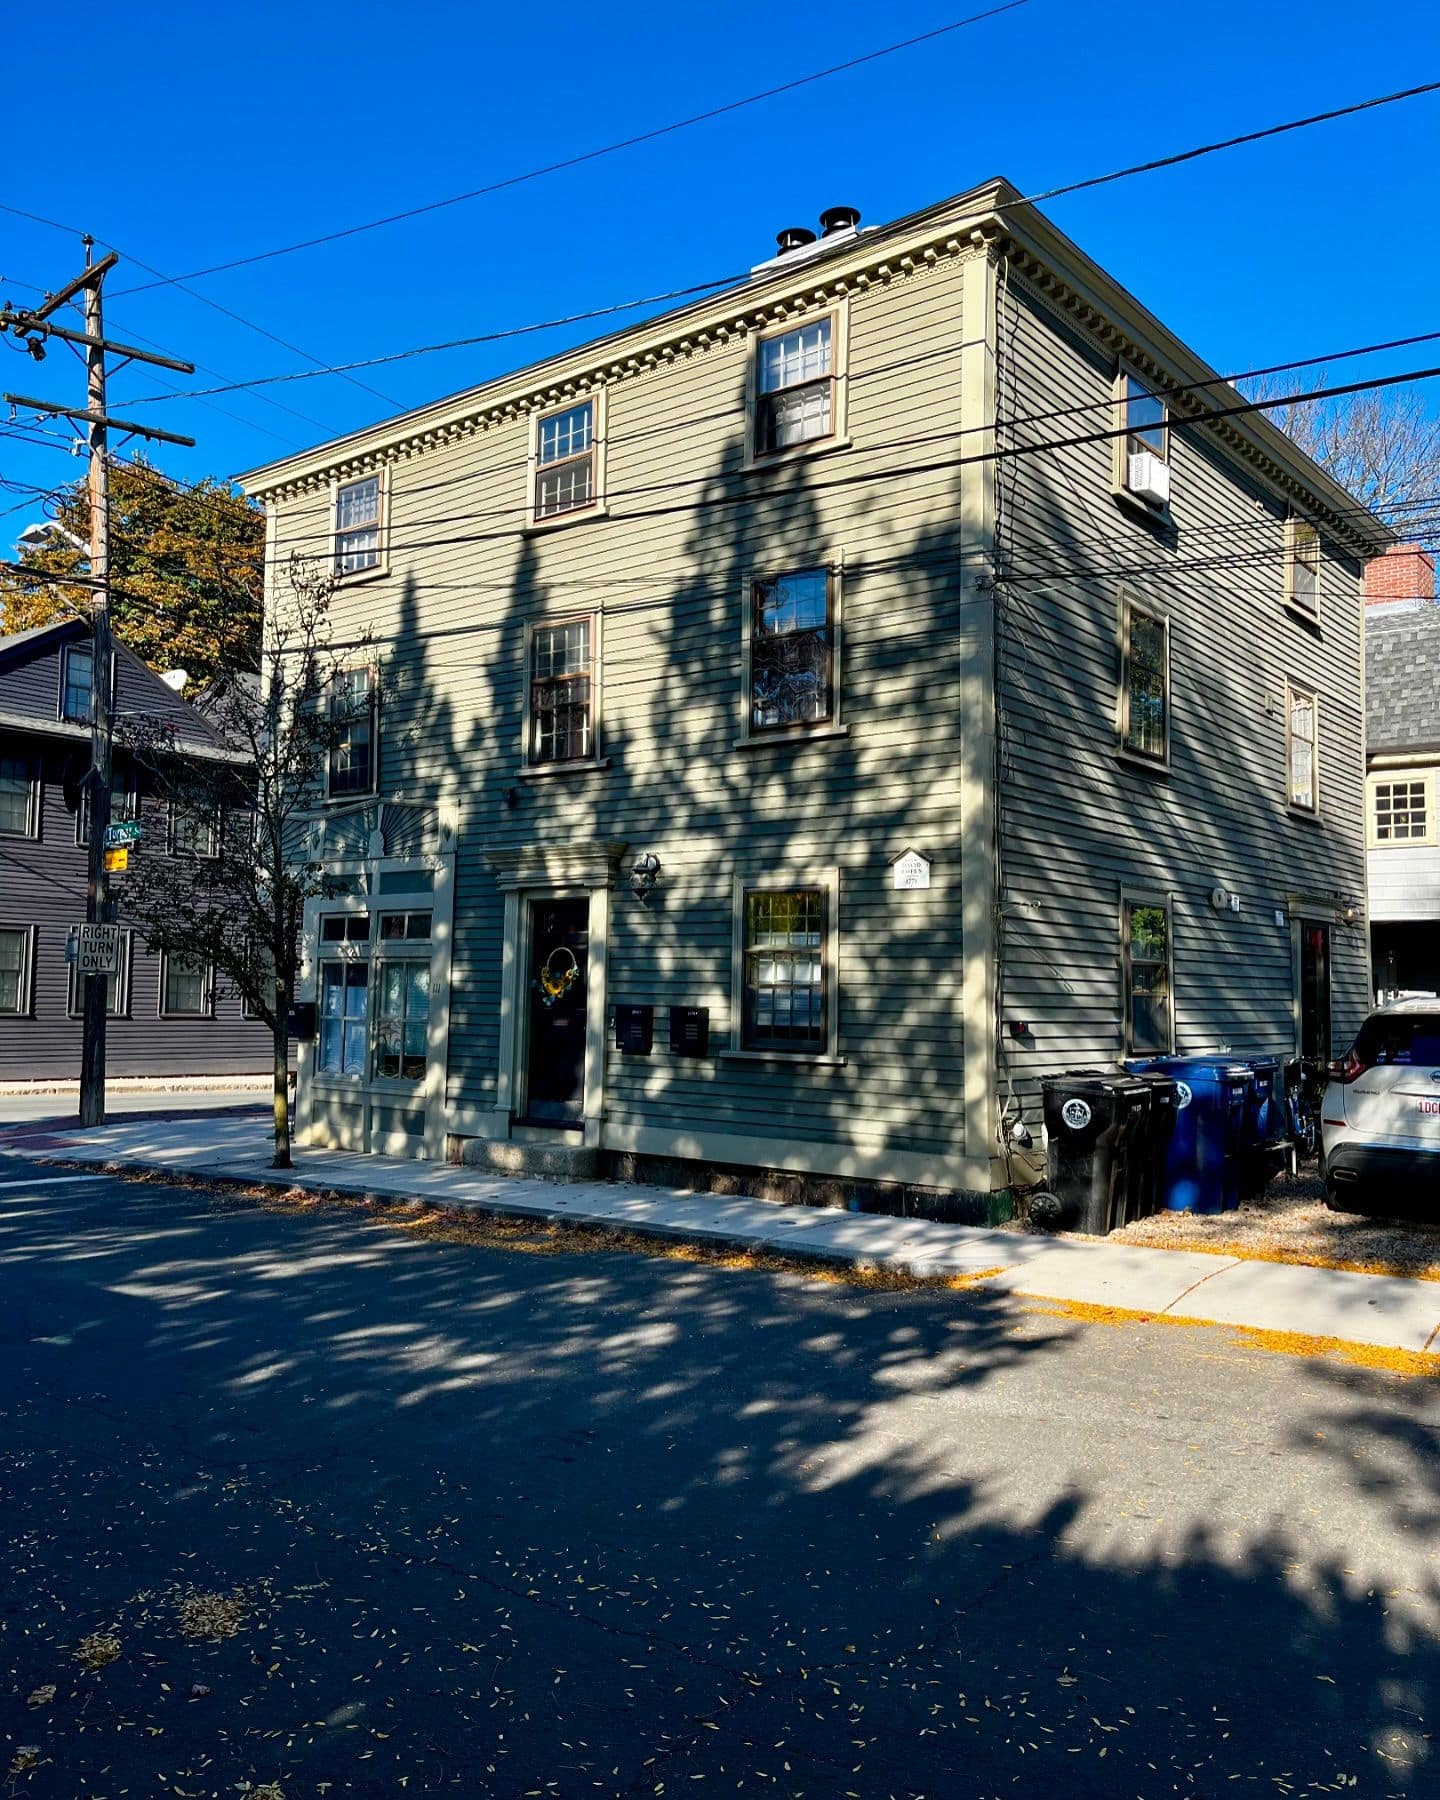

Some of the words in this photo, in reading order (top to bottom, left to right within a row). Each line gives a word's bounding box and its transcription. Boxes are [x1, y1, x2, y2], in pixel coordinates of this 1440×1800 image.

[82, 926, 117, 939] RIGHT
[82, 941, 114, 954] TURN
[82, 956, 113, 968] ONLY
[1418, 1101, 1440, 1114] 1DC
